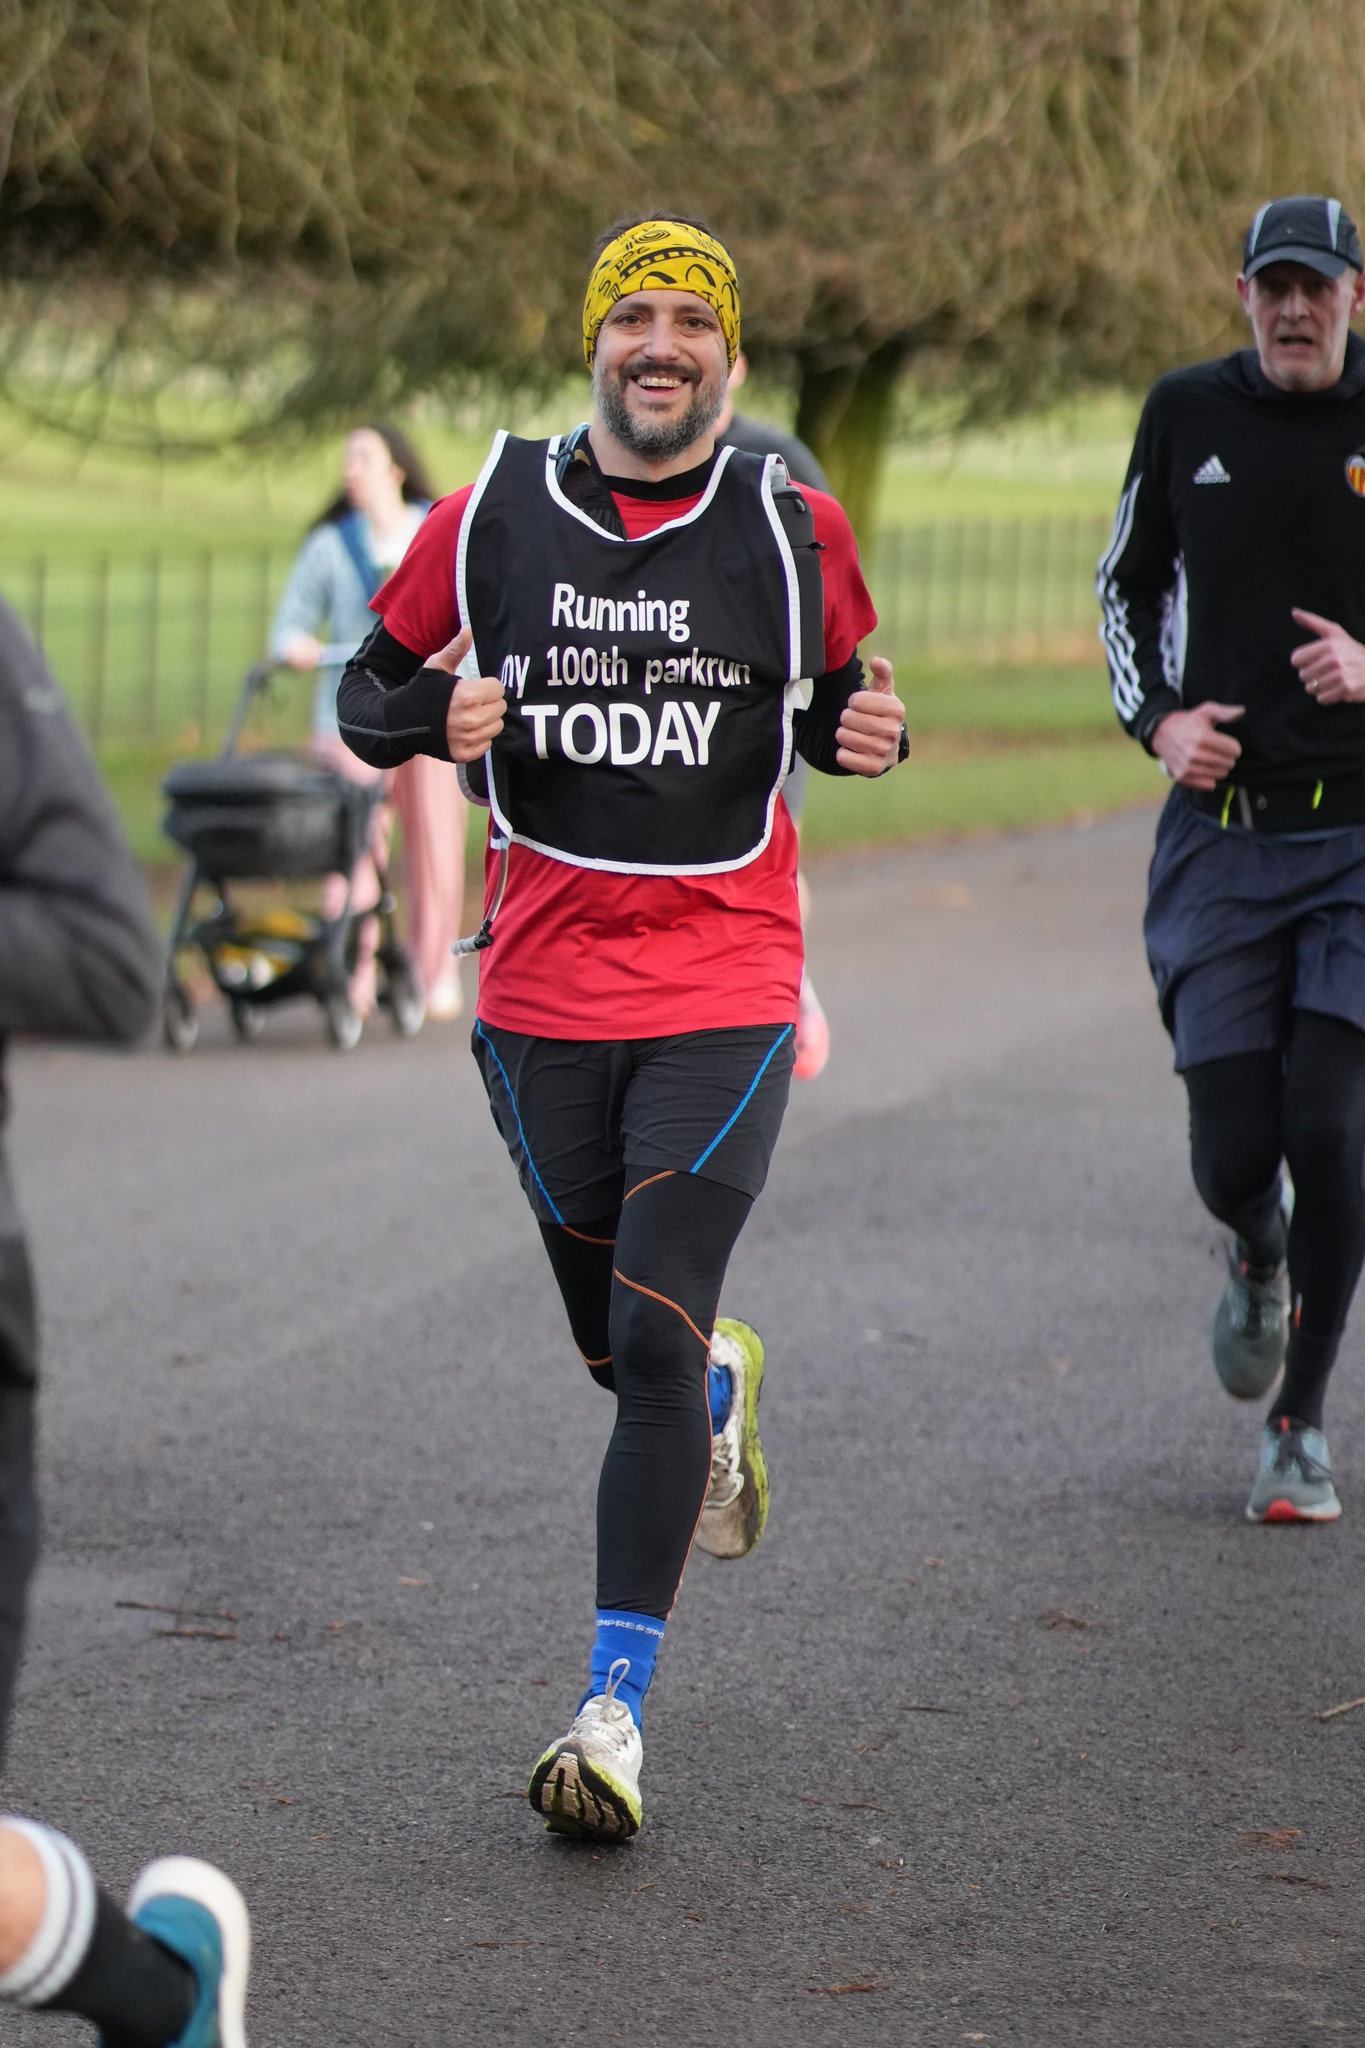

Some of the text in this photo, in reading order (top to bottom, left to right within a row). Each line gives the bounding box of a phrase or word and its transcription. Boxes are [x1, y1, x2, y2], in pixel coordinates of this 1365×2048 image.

[552, 582, 691, 643] Running
[501, 645, 751, 699] my 100th parkrun
[520, 701, 721, 766] TODAY
